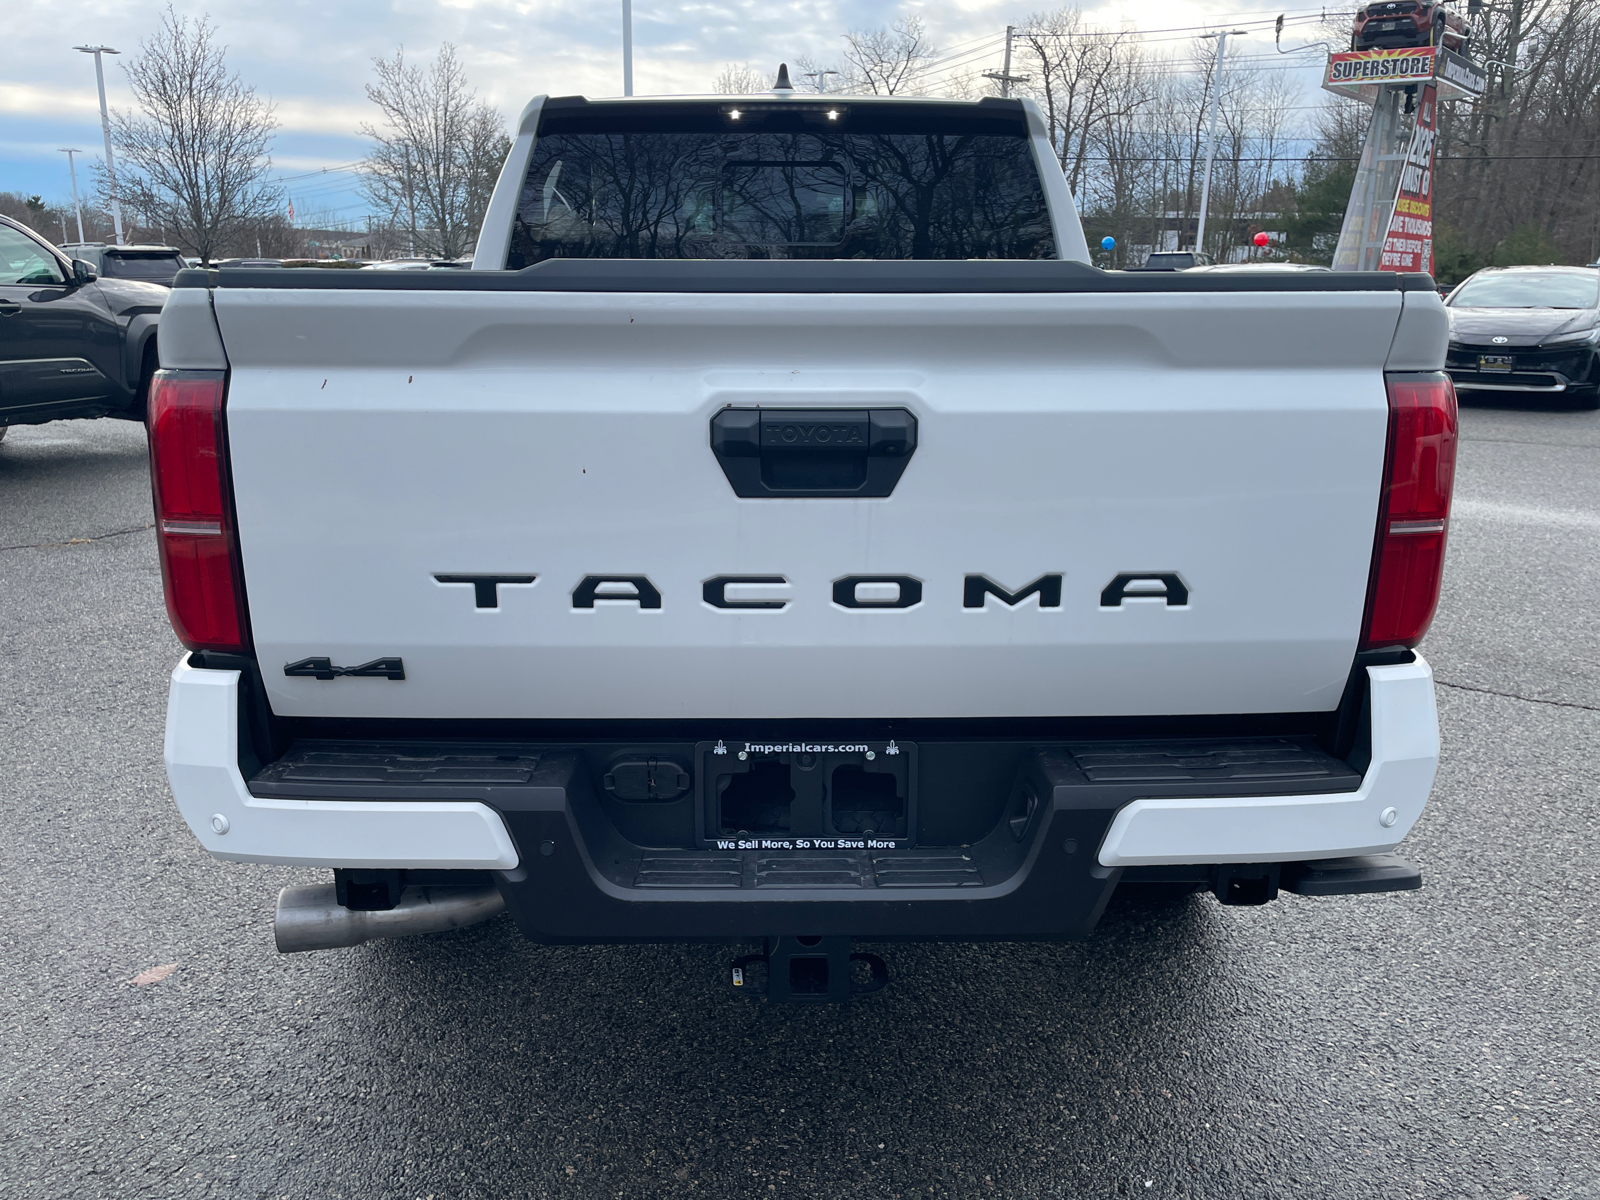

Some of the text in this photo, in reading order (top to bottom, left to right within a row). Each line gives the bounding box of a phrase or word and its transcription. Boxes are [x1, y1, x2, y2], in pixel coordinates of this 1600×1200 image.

[1332, 55, 1431, 80] SUPERSTORE
[1389, 215, 1404, 232] AVE
[766, 425, 864, 443] TOYOTA
[432, 571, 1191, 611] TACOMA
[744, 742, 869, 754] Imperialcars.com
[717, 839, 896, 850] We Sell More, So You Save More
